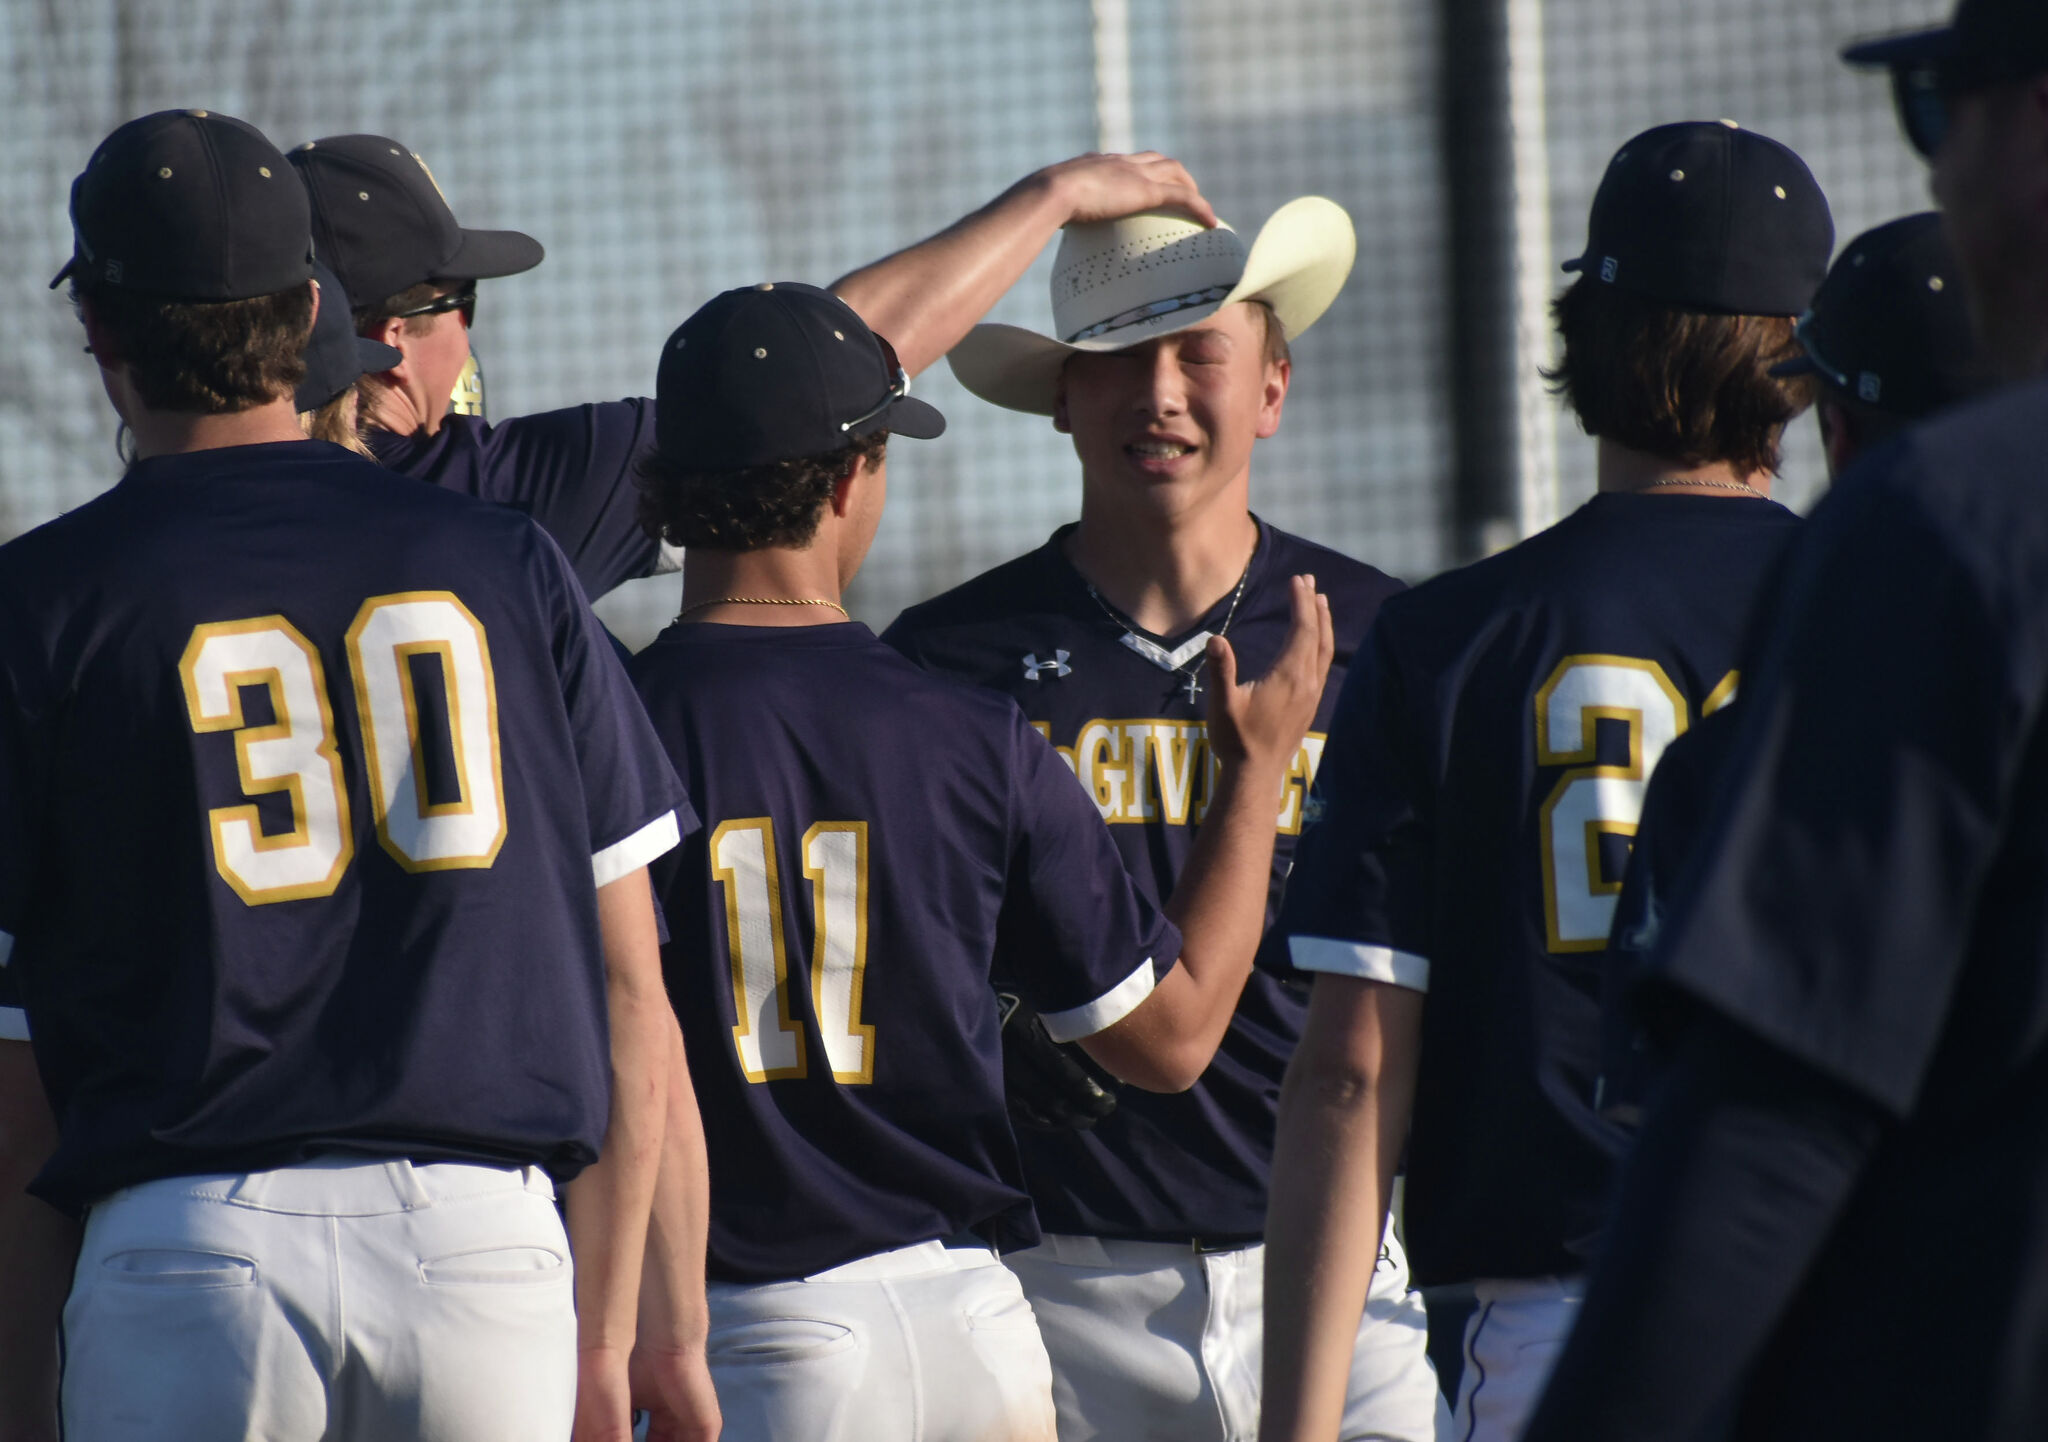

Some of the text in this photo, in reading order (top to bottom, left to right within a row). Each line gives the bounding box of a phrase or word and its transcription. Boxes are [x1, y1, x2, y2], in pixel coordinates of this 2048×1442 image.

[178, 590, 508, 907] 30
[1534, 653, 1741, 953] 2
[709, 816, 876, 1085] 11
